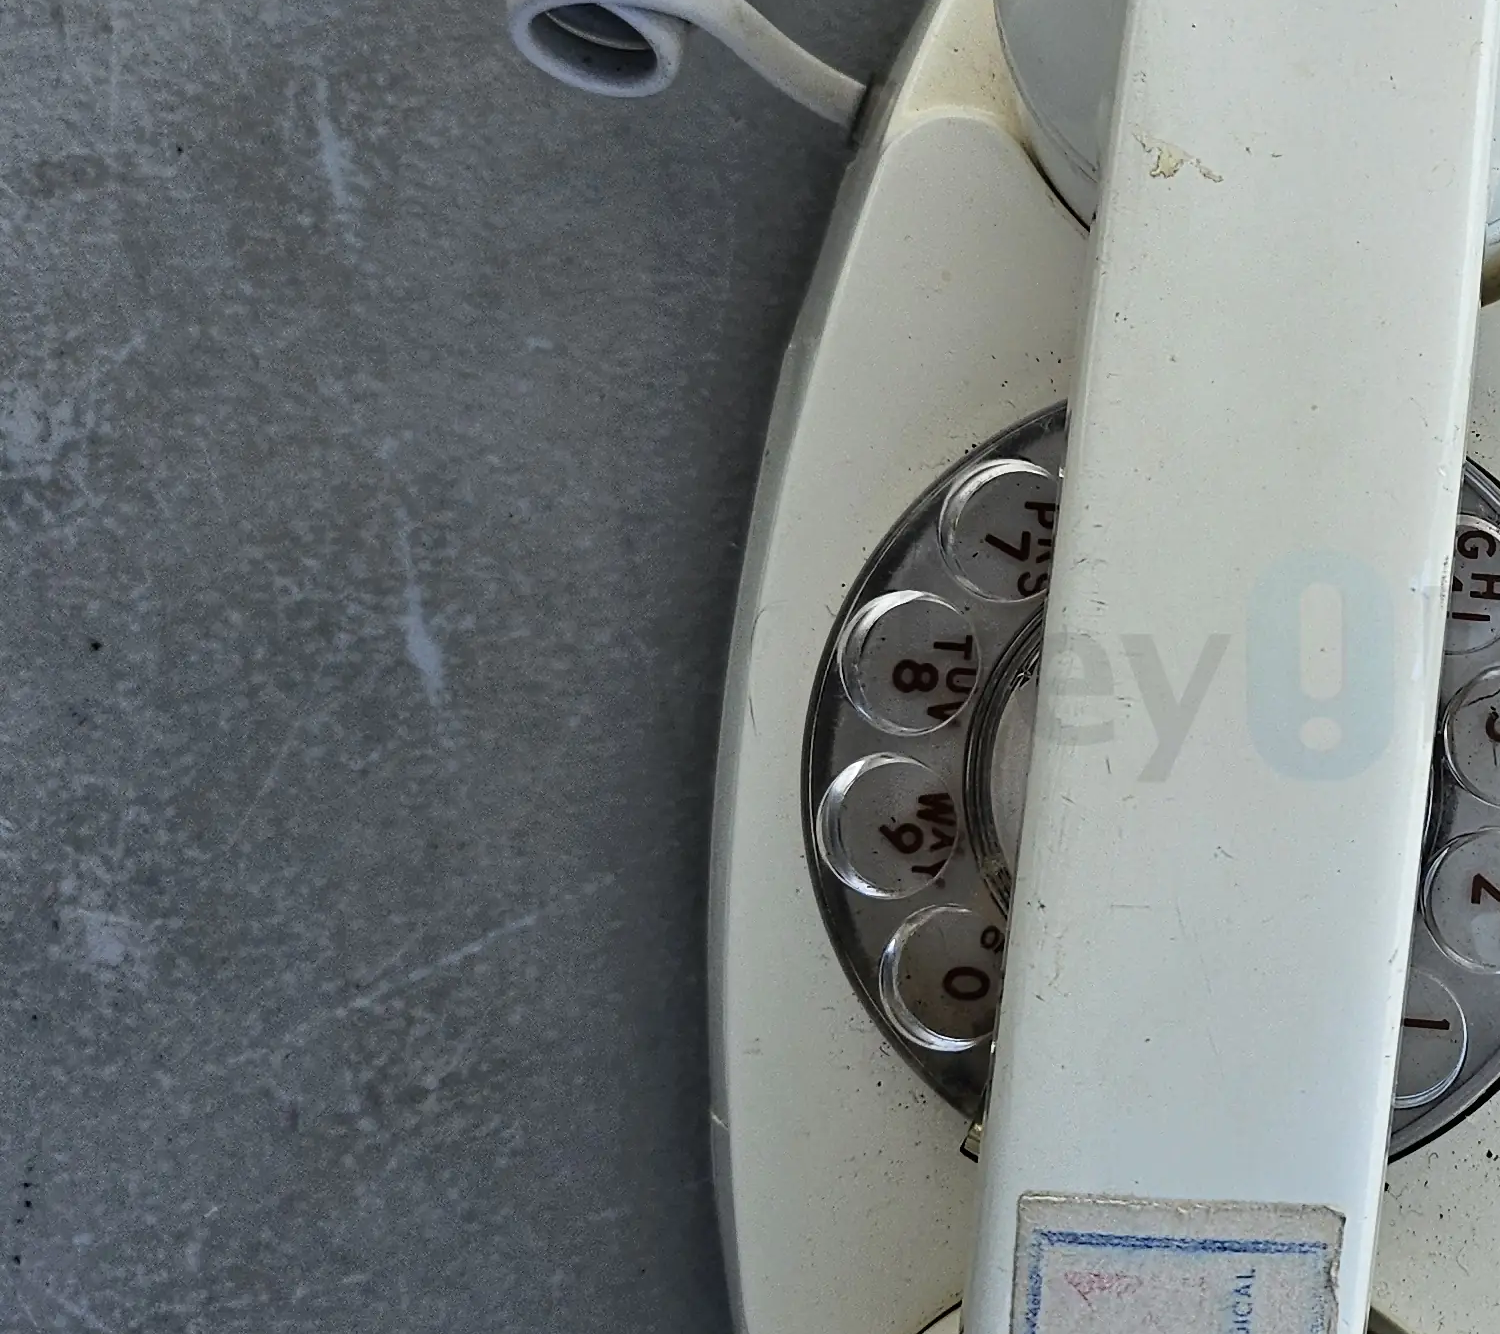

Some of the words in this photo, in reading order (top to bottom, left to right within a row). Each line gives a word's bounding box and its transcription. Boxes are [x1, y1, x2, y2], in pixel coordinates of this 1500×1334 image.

[985, 530, 1031, 562] 7
[892, 658, 939, 694] 8
[926, 634, 977, 728] TUV
[878, 822, 924, 855] 9
[911, 792, 963, 889] WXY
[942, 966, 991, 1001] 0
[1403, 1017, 1450, 1031] 1
